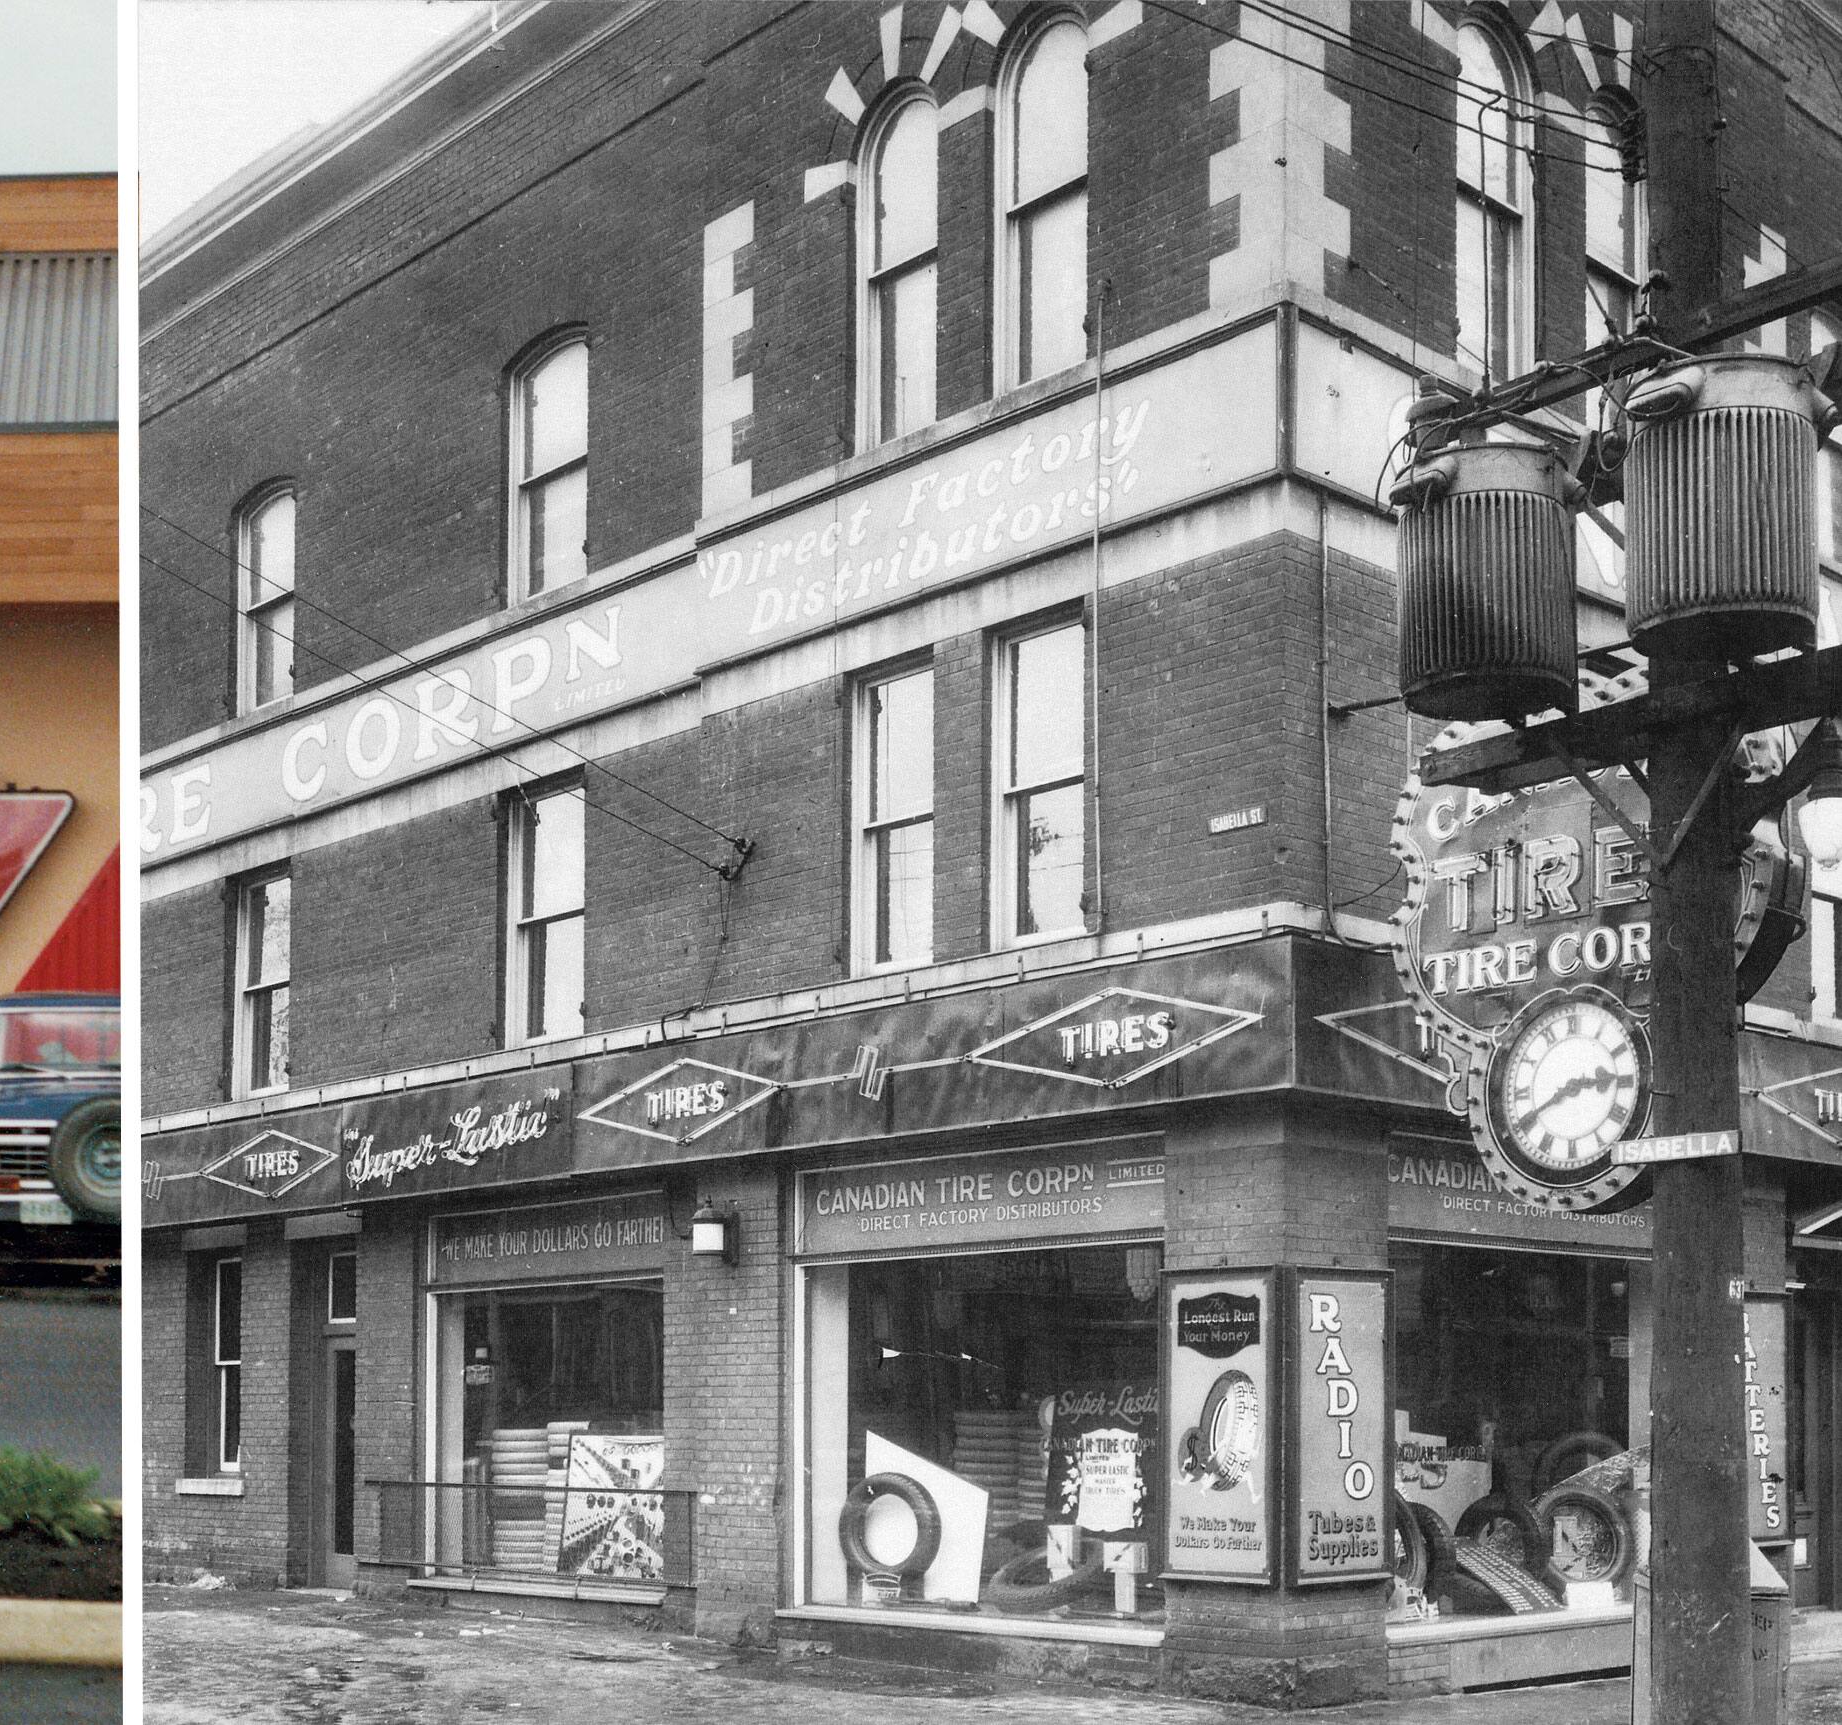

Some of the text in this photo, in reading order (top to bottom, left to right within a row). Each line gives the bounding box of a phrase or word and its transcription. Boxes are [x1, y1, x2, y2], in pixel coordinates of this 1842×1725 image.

[898, 399, 1150, 528] Factory
[748, 460, 1140, 636] Distributors"
[281, 604, 624, 802] CORPN
[553, 677, 629, 713] LIMITED
[1430, 820, 1650, 932] TIRE
[1423, 921, 1651, 998] TIRE COR
[1057, 1012, 1177, 1066] TIRES
[644, 1080, 728, 1125] TIRES
[243, 1149, 301, 1181] TIRES
[1617, 1132, 1734, 1163] ISABELLA
[816, 1163, 1166, 1216] CANADIAN TIRE CORPN LIMITED
[919, 1207, 989, 1228] FACTORY
[1497, 1200, 1555, 1220] FACTORY
[444, 1239, 460, 1261] WE
[464, 1233, 494, 1259] MAKE
[498, 1230, 528, 1256] YOUR
[532, 1223, 589, 1254] DOLLARS
[593, 1221, 613, 1249] GO
[1183, 1309, 1255, 1326] Longest Run
[1183, 1330, 1251, 1347] Your Money
[1058, 1385, 1158, 1425] Super-Lasti
[1308, 1293, 1375, 1500] RADIO
[1095, 1437, 1119, 1454] TIRE
[1175, 1535, 1210, 1549] Dollars
[1213, 1536, 1226, 1549] Go
[1180, 1516, 1256, 1533] We Make Your
[1307, 1534, 1379, 1566] Supplies
